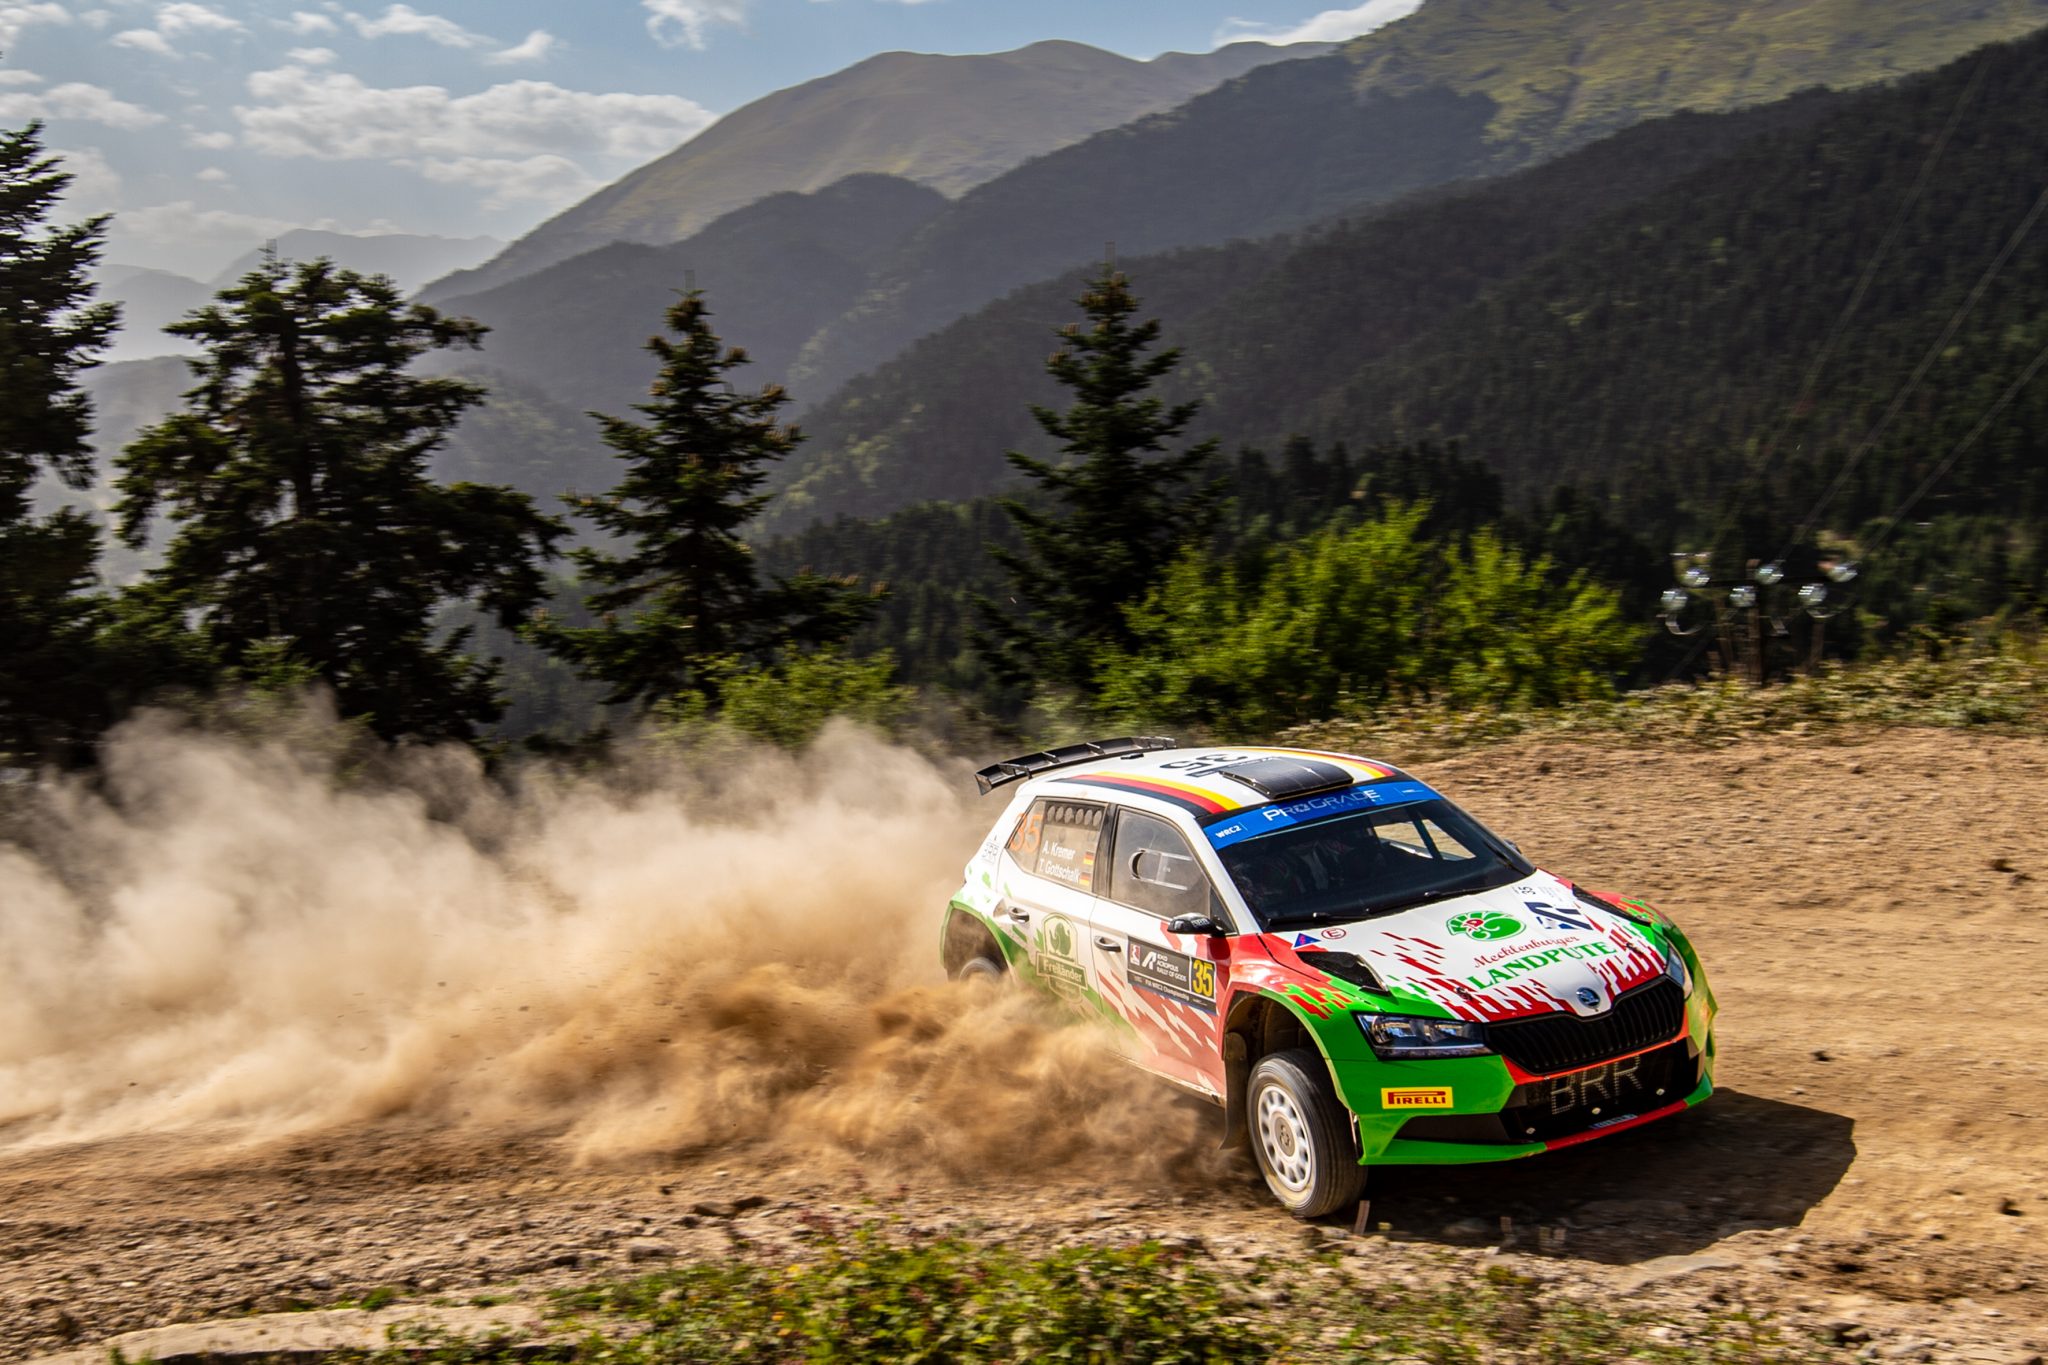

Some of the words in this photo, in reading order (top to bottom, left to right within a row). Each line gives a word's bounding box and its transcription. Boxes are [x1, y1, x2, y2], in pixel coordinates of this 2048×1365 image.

[1215, 825, 1242, 839] WRC2
[1052, 842, 1076, 860] Kremer
[1045, 861, 1080, 883] Gottschalk
[1466, 941, 1617, 989] LANDPUTE
[1473, 935, 1581, 968] Mecklenburger
[1193, 959, 1214, 997] 35
[1550, 1054, 1642, 1114] BRR
[1388, 1091, 1446, 1105] PIRELLI
